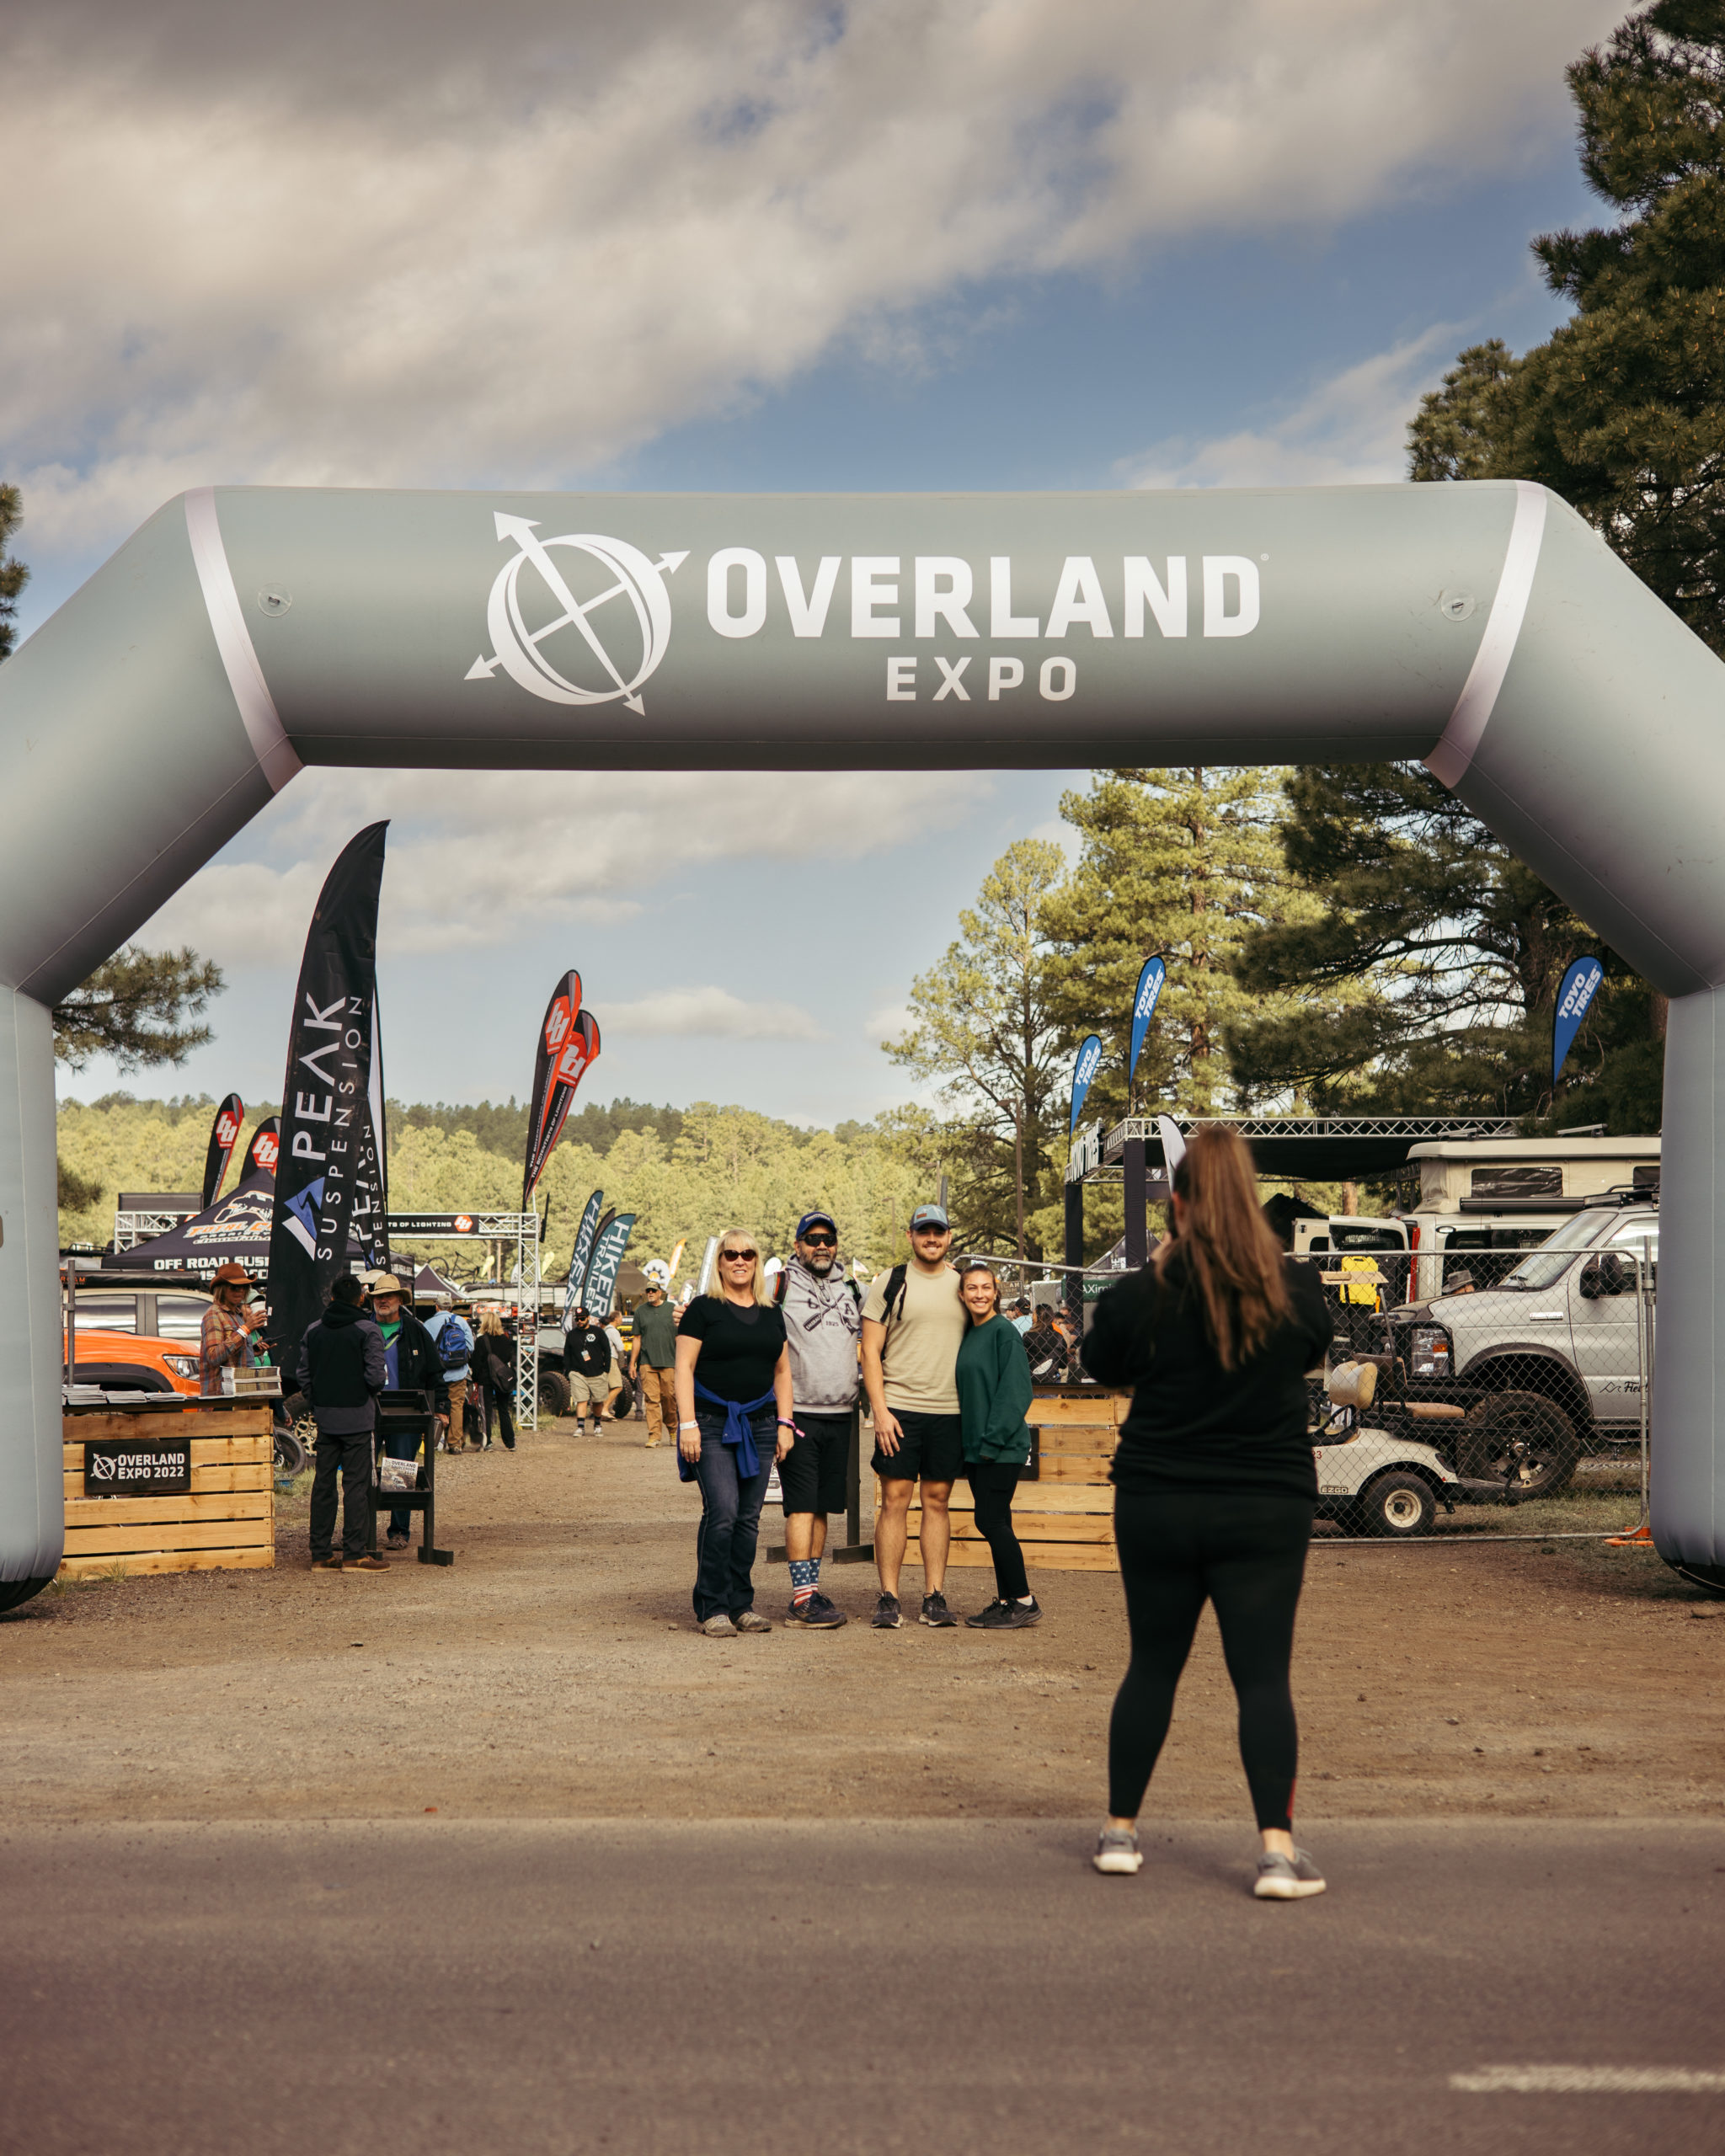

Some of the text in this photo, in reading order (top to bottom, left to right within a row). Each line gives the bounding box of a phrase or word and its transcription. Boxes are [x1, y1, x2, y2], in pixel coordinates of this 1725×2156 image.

[707, 546, 1261, 638] OVERLAND
[886, 656, 1076, 702] EXPO
[1135, 974, 1154, 1019] TOYO
[1144, 969, 1164, 1017] TIRES
[1558, 973, 1585, 1019] TOYO
[1572, 968, 1600, 1017] TIRES
[292, 992, 346, 1161] PEAK
[1075, 1049, 1092, 1086] TOYO
[1082, 1045, 1101, 1086] TIRES
[318, 996, 362, 1261] SUSPENSION
[154, 1259, 183, 1270] OFF
[187, 1257, 229, 1269] ROAD
[585, 1234, 611, 1311] TRAILER
[590, 1220, 630, 1316] HIKER
[118, 1453, 185, 1466] OVERLAND
[118, 1465, 184, 1480] EXPO 2022
